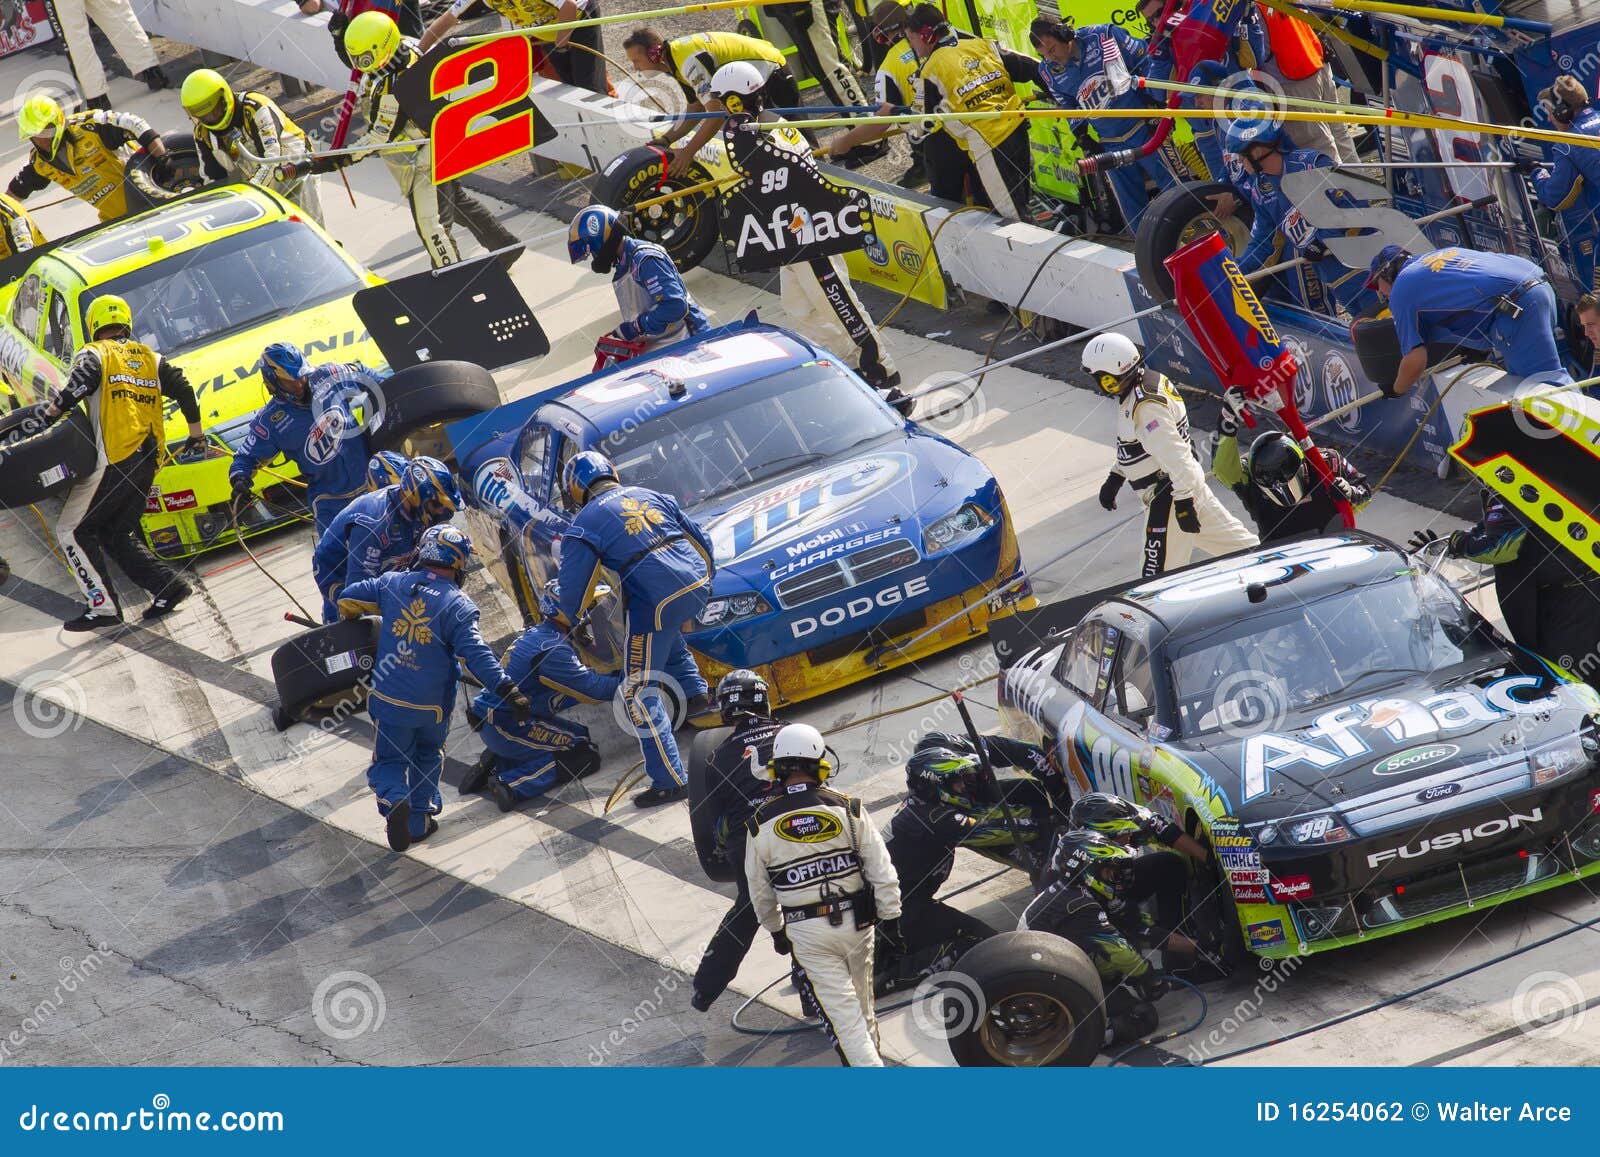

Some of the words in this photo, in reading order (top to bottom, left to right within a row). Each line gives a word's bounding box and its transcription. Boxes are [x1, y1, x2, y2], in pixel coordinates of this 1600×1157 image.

[430, 34, 534, 186] 2
[760, 166, 789, 194] 99
[736, 202, 864, 258] Aflac
[826, 283, 856, 324] Sprint
[770, 527, 902, 580] CHARGER
[786, 529, 843, 558] Mobil
[1144, 539, 1162, 578] Sprin
[702, 600, 725, 625] 2
[790, 575, 930, 638] DODGE
[1242, 676, 1543, 804] Aflac
[1387, 749, 1446, 772] Scotts
[1424, 786, 1454, 800] Ford
[791, 816, 815, 828] NASCAR
[797, 822, 820, 834] Sprint
[1298, 818, 1331, 841] 99
[1216, 836, 1252, 846] MOOG
[1366, 808, 1544, 869] FUSION
[786, 854, 857, 884] OFFICIAL
[1221, 853, 1260, 868] MAHLE
[1230, 872, 1258, 881] COMP
[1271, 882, 1311, 895] Raybestos
